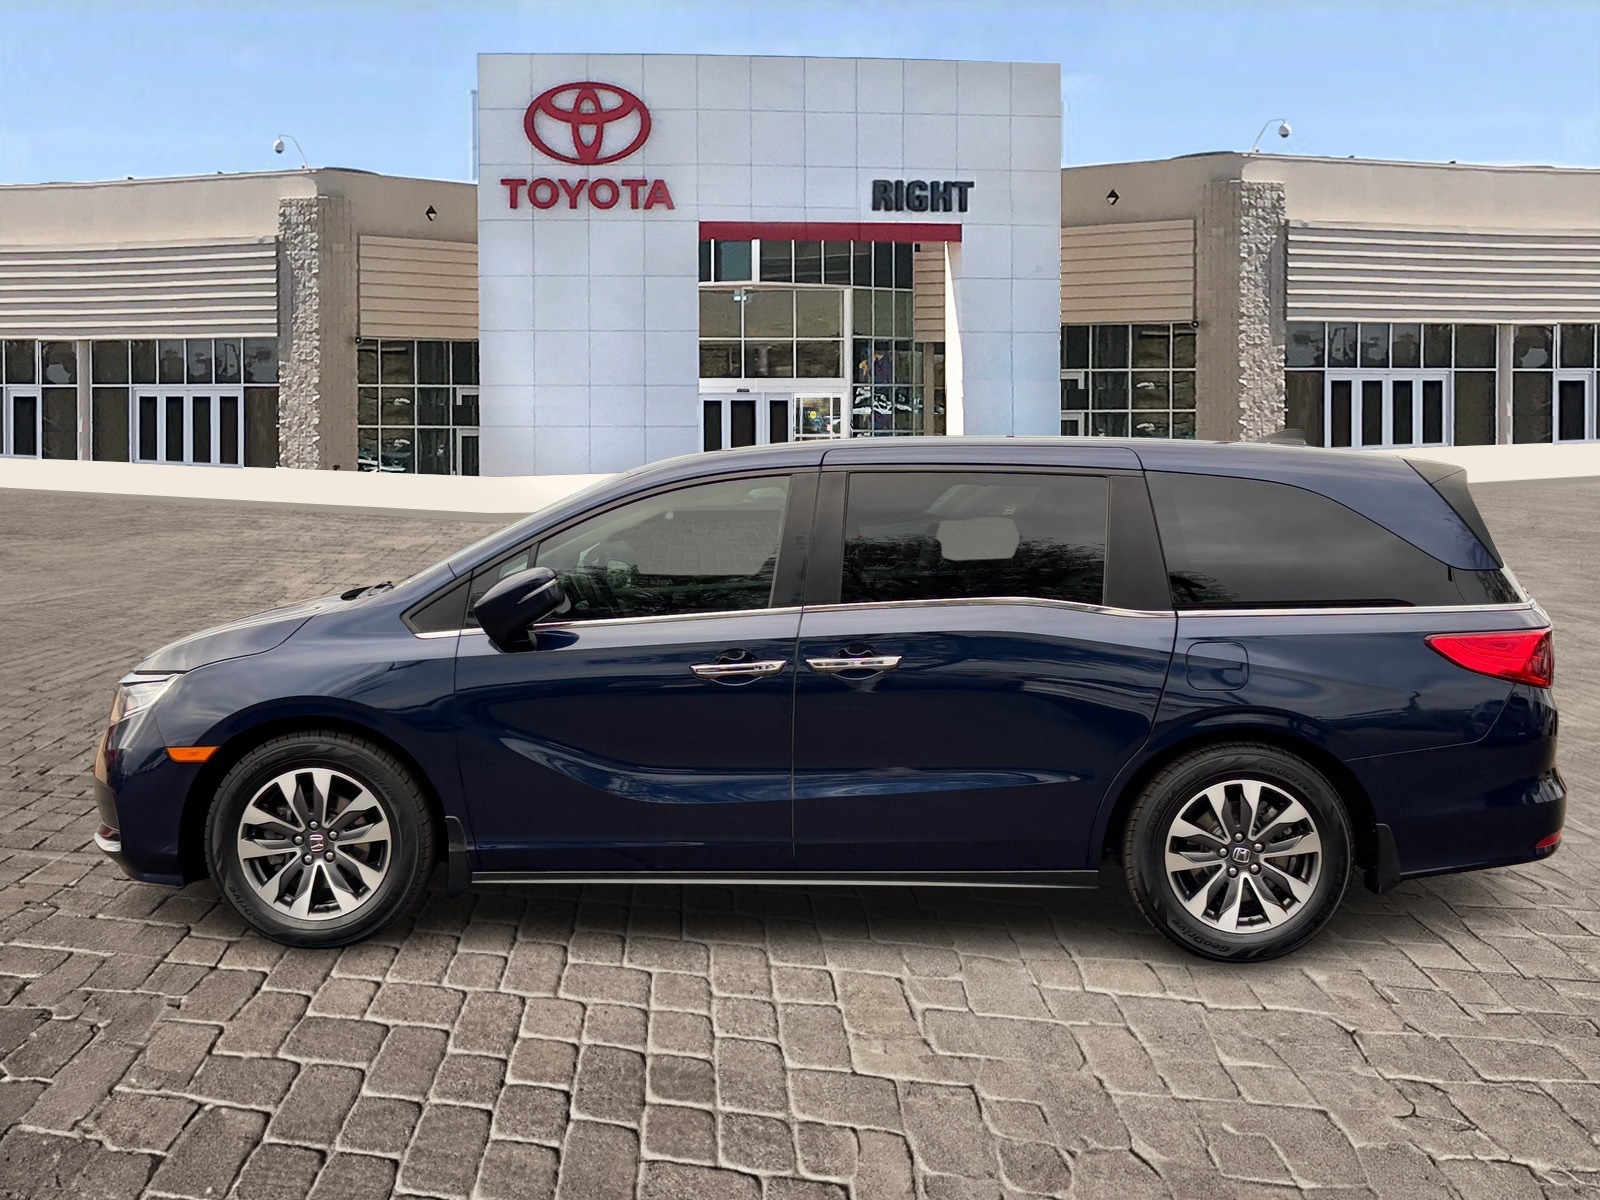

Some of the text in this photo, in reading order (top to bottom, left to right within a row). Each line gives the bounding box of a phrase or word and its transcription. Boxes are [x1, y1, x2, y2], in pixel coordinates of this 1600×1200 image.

[501, 178, 675, 210] TOYOTA
[871, 179, 975, 213] RIGHT
[1258, 763, 1317, 798] GeoDrive
[1171, 918, 1233, 954] GeoDrive
